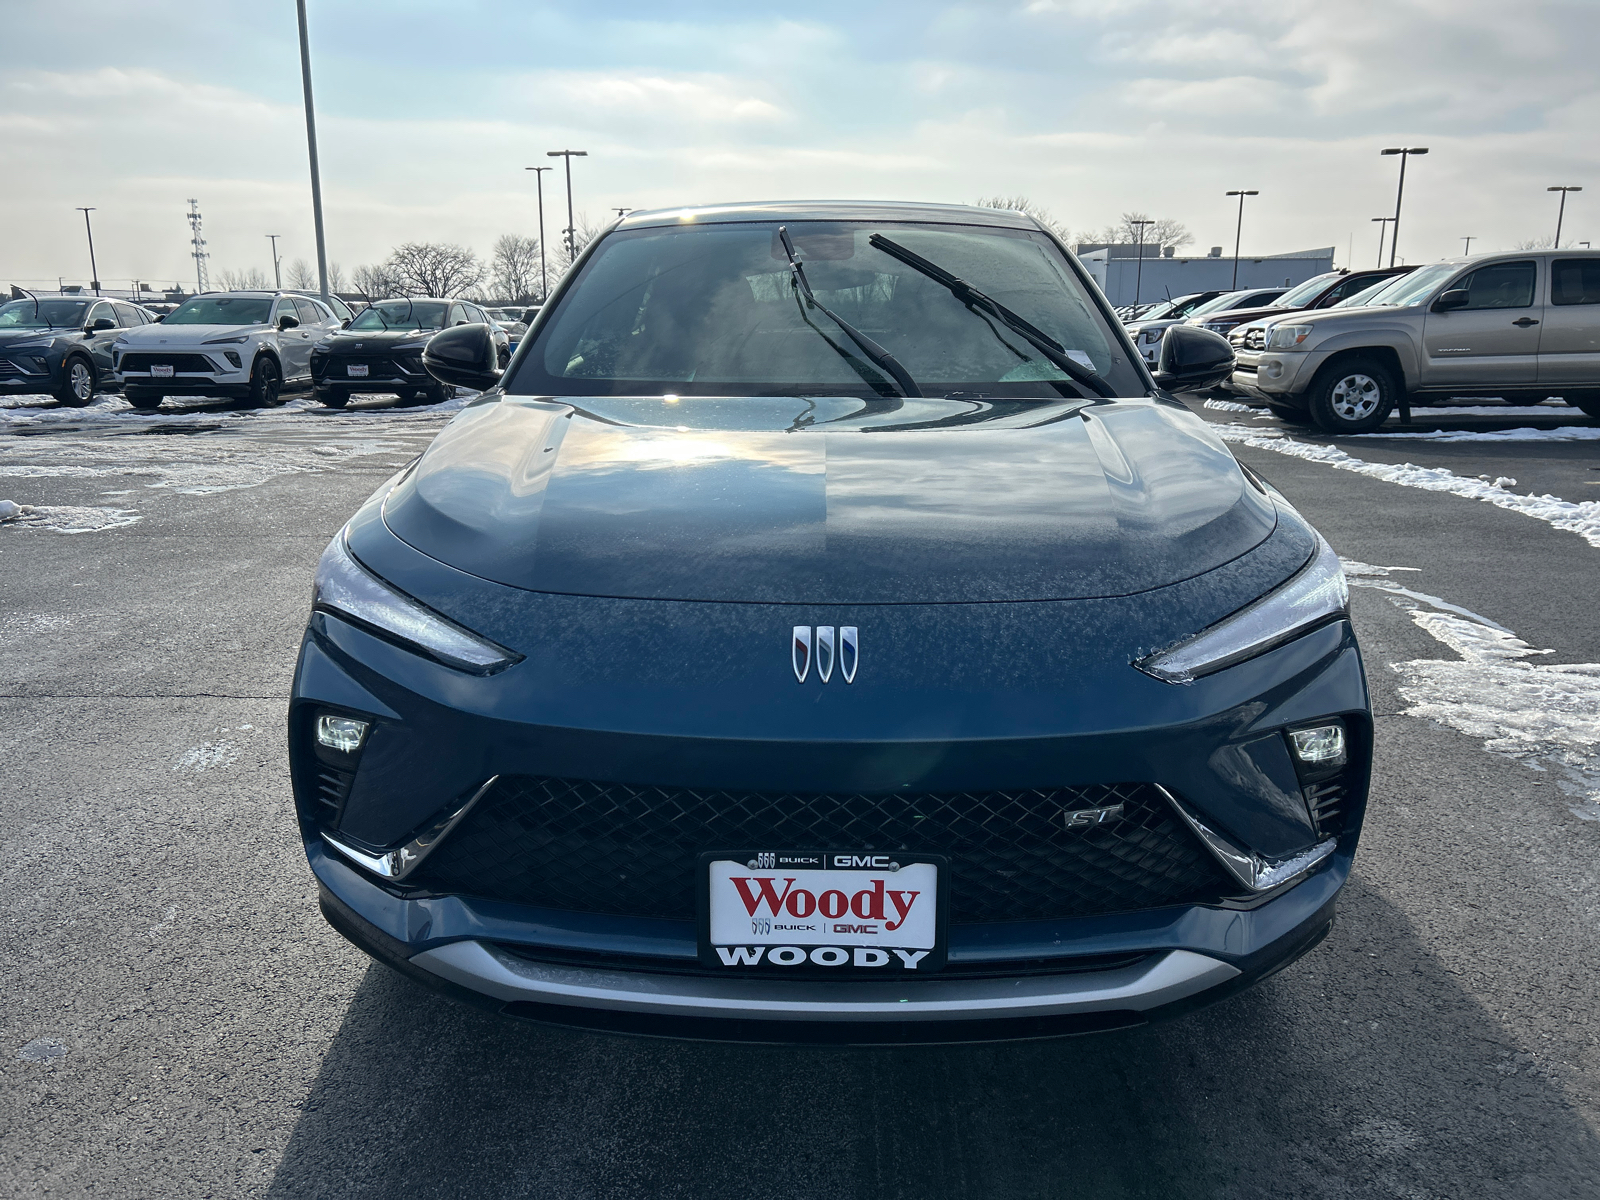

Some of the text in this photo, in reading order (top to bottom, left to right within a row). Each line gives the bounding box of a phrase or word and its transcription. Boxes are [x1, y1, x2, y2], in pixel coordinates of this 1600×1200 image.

[833, 855, 890, 868] GMC
[729, 877, 921, 931] Woody
[833, 923, 878, 934] GMC
[715, 946, 930, 969] WOODY
